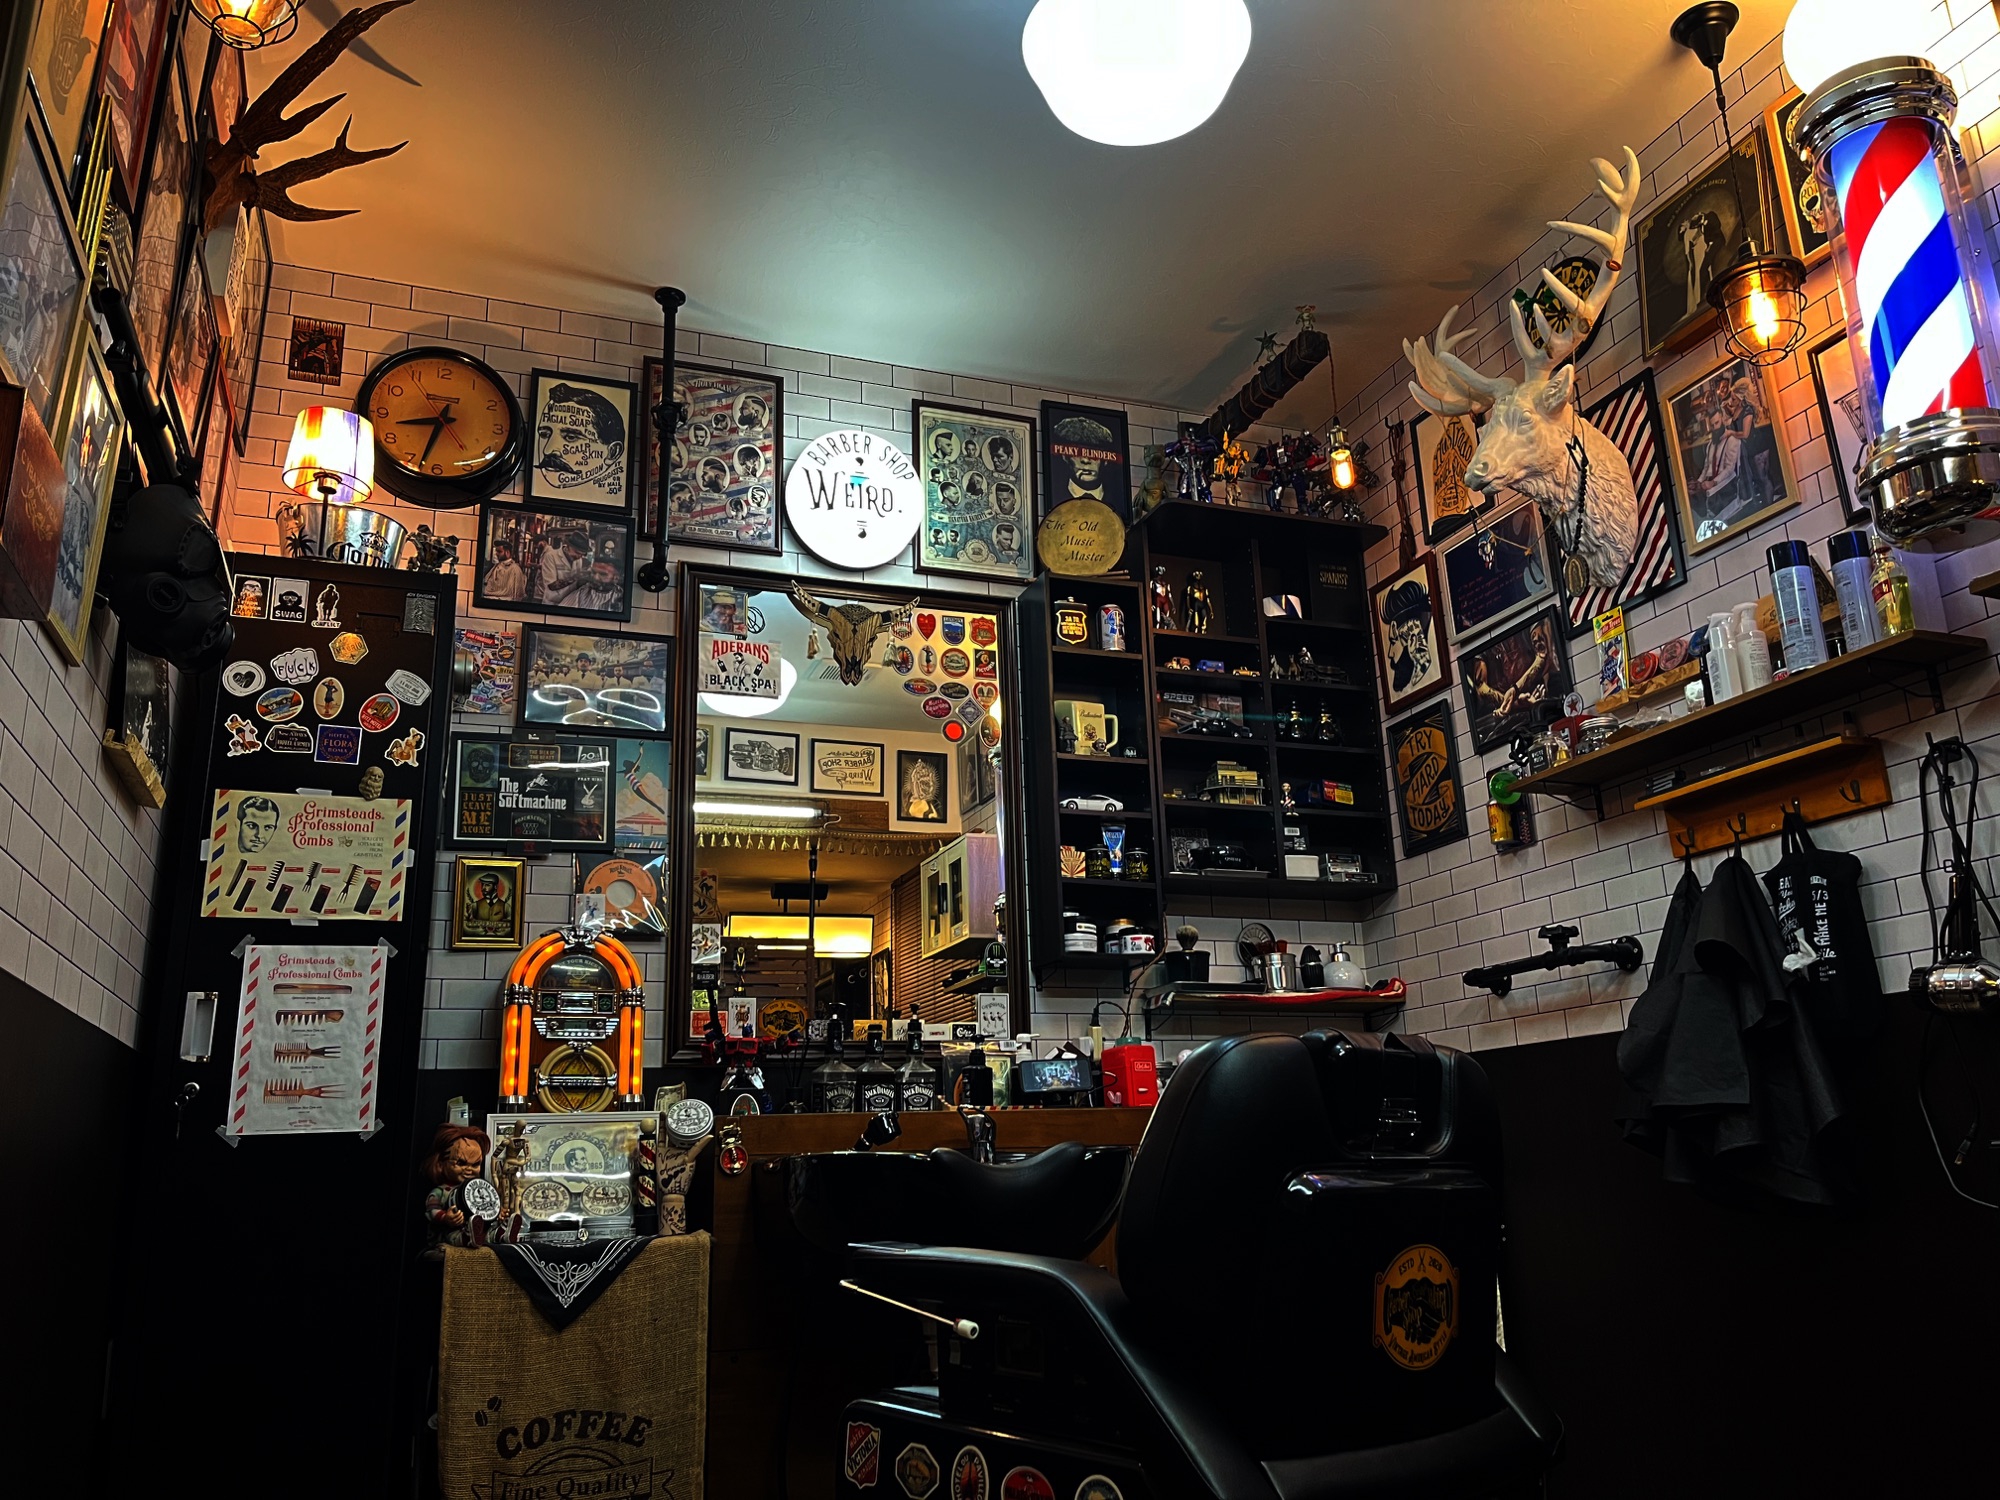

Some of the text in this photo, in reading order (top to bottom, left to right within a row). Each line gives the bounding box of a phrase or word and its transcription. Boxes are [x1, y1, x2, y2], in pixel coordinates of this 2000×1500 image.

[411, 369, 422, 382] 11
[437, 367, 452, 380] 12
[387, 384, 404, 397] 10
[376, 406, 389, 419] 9
[486, 400, 498, 411] 2
[542, 412, 592, 428] FACIAL SOAP
[492, 424, 504, 435] 3
[384, 432, 397, 444] 8
[563, 443, 591, 456] SCALP
[582, 449, 603, 460] SKIN
[807, 433, 915, 480] BARBER SHOP
[1054, 444, 1117, 461] PEAKY BLINDERS
[404, 452, 416, 463] 7
[431, 463, 443, 476] 6
[558, 463, 604, 483] COMPLEXION
[1045, 519, 1066, 531] The
[1060, 535, 1095, 547] Music
[274, 609, 303, 619] SWAG
[312, 620, 341, 628] CONFLICT
[711, 639, 770, 665] ADERANS
[277, 660, 316, 676] FUCK
[710, 674, 772, 689] BLACK SPA
[1163, 692, 1195, 701] SPEED
[323, 738, 353, 749] FLORA
[1406, 728, 1433, 757] TRY
[499, 777, 519, 793] The
[1411, 757, 1440, 803] HARD
[463, 792, 493, 801] JUST
[499, 793, 567, 810] Softmachine
[462, 811, 492, 825] ME
[1410, 797, 1450, 827] TODAY
[287, 813, 375, 833] Professional
[293, 832, 334, 849] Combs
[1814, 902, 1827, 917] ME
[279, 953, 335, 967] Grimsteads
[267, 966, 363, 981] Professional Combs
[1398, 1257, 1416, 1275] ESTD
[496, 1408, 653, 1460] COFFEE
[847, 1432, 878, 1471] VICTORIA
[501, 1471, 644, 1500] Fine Quality
